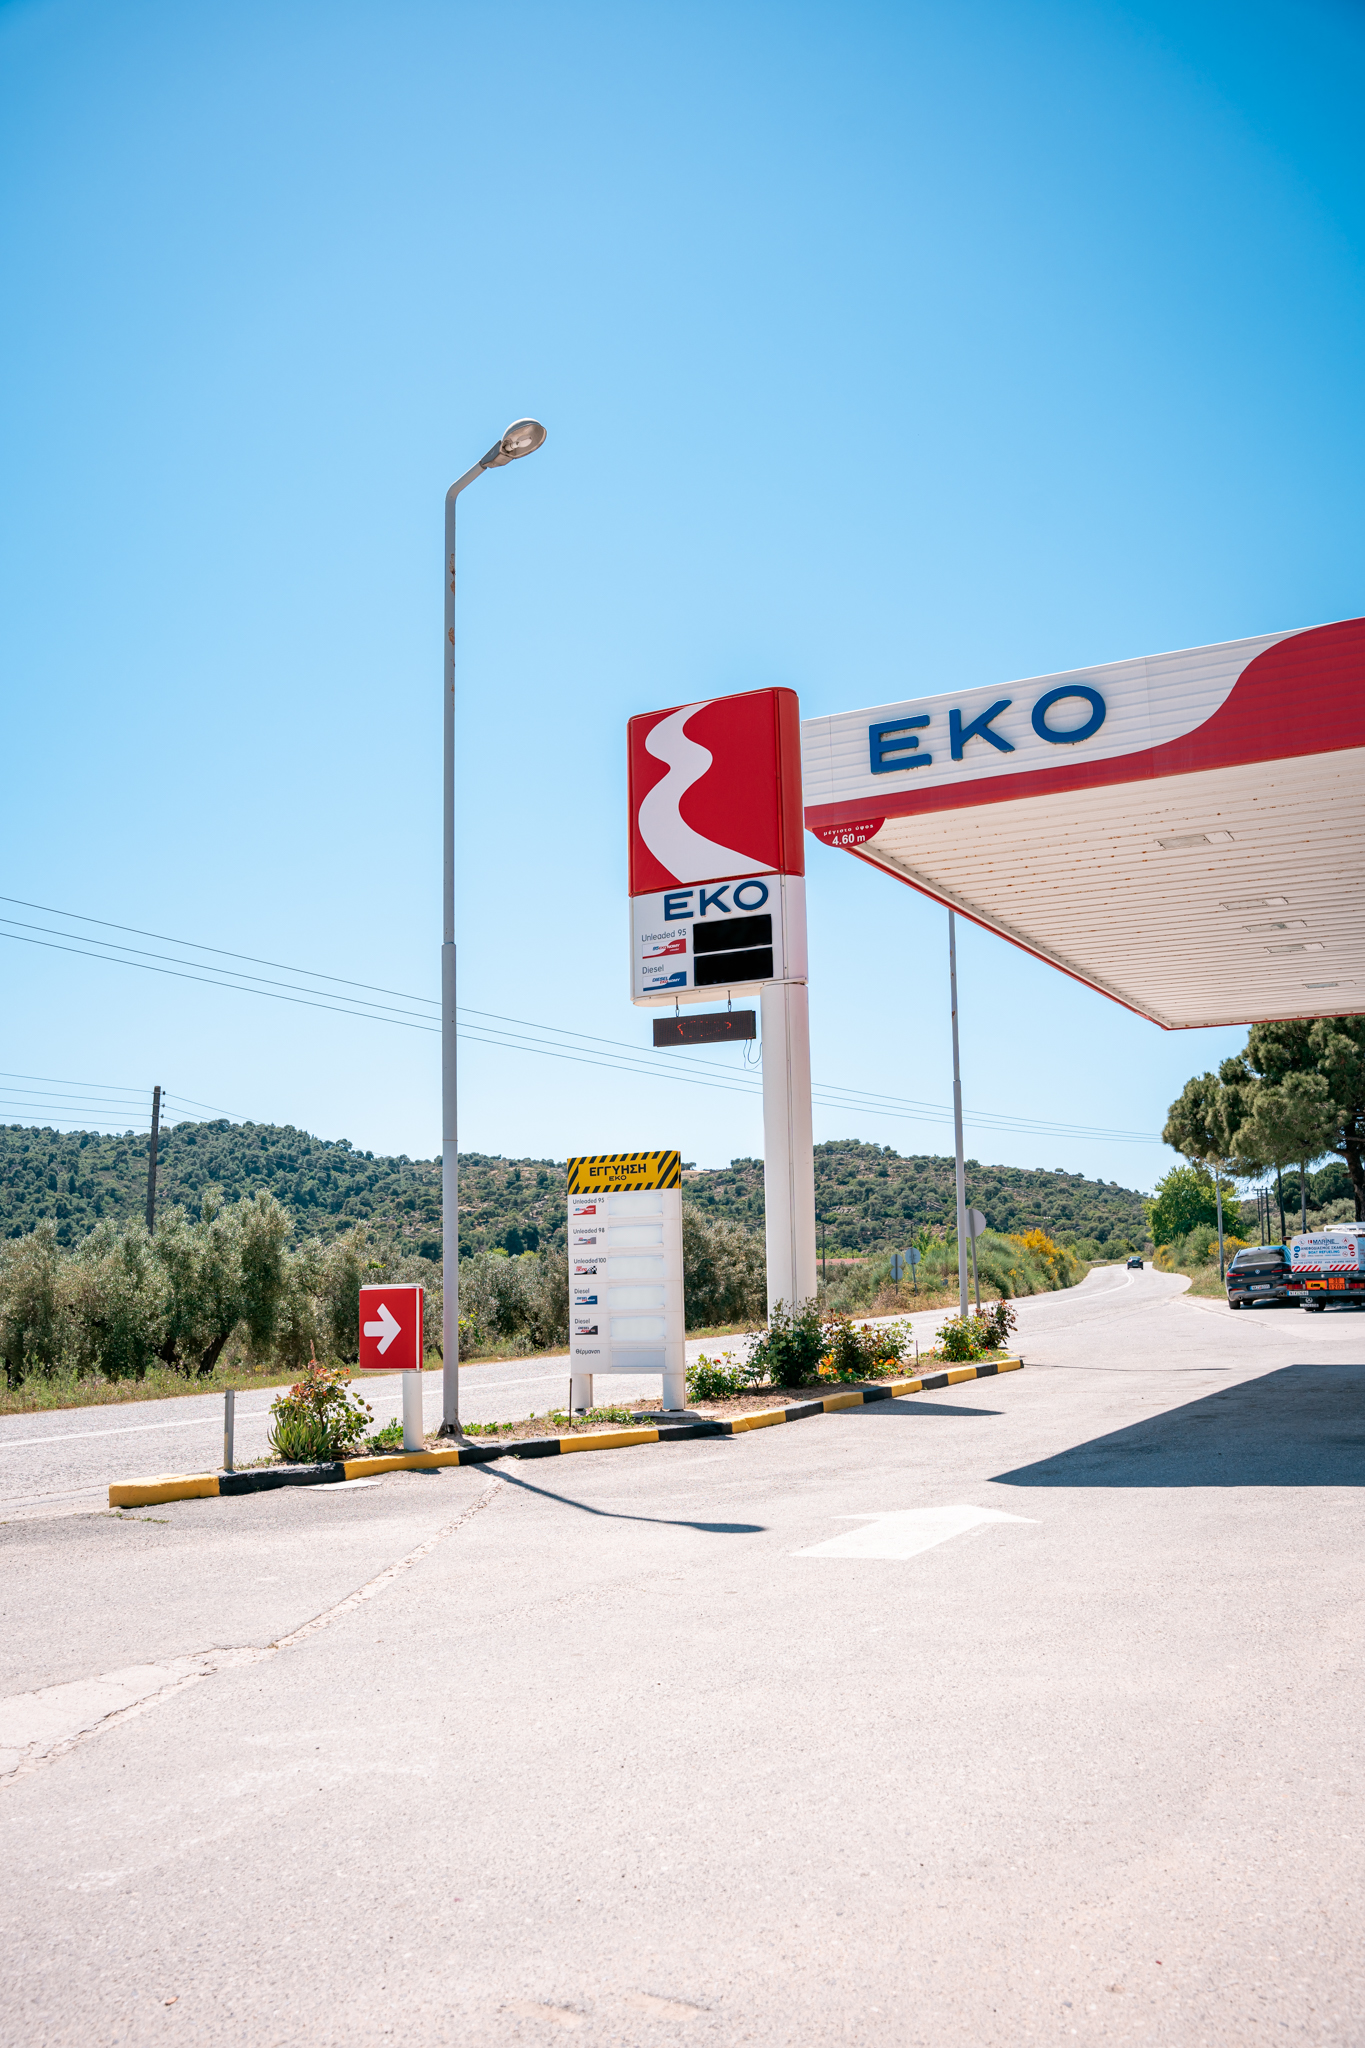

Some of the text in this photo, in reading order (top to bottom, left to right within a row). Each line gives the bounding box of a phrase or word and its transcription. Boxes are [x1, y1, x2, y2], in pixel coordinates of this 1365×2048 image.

[869, 684, 1107, 776] EKO
[832, 834, 854, 845] 4.60
[664, 880, 769, 922] EKO
[641, 928, 687, 942] Unleaded 95
[642, 964, 664, 974] Diesel
[589, 1163, 647, 1177] ΕΓΓΥΗΣΗ
